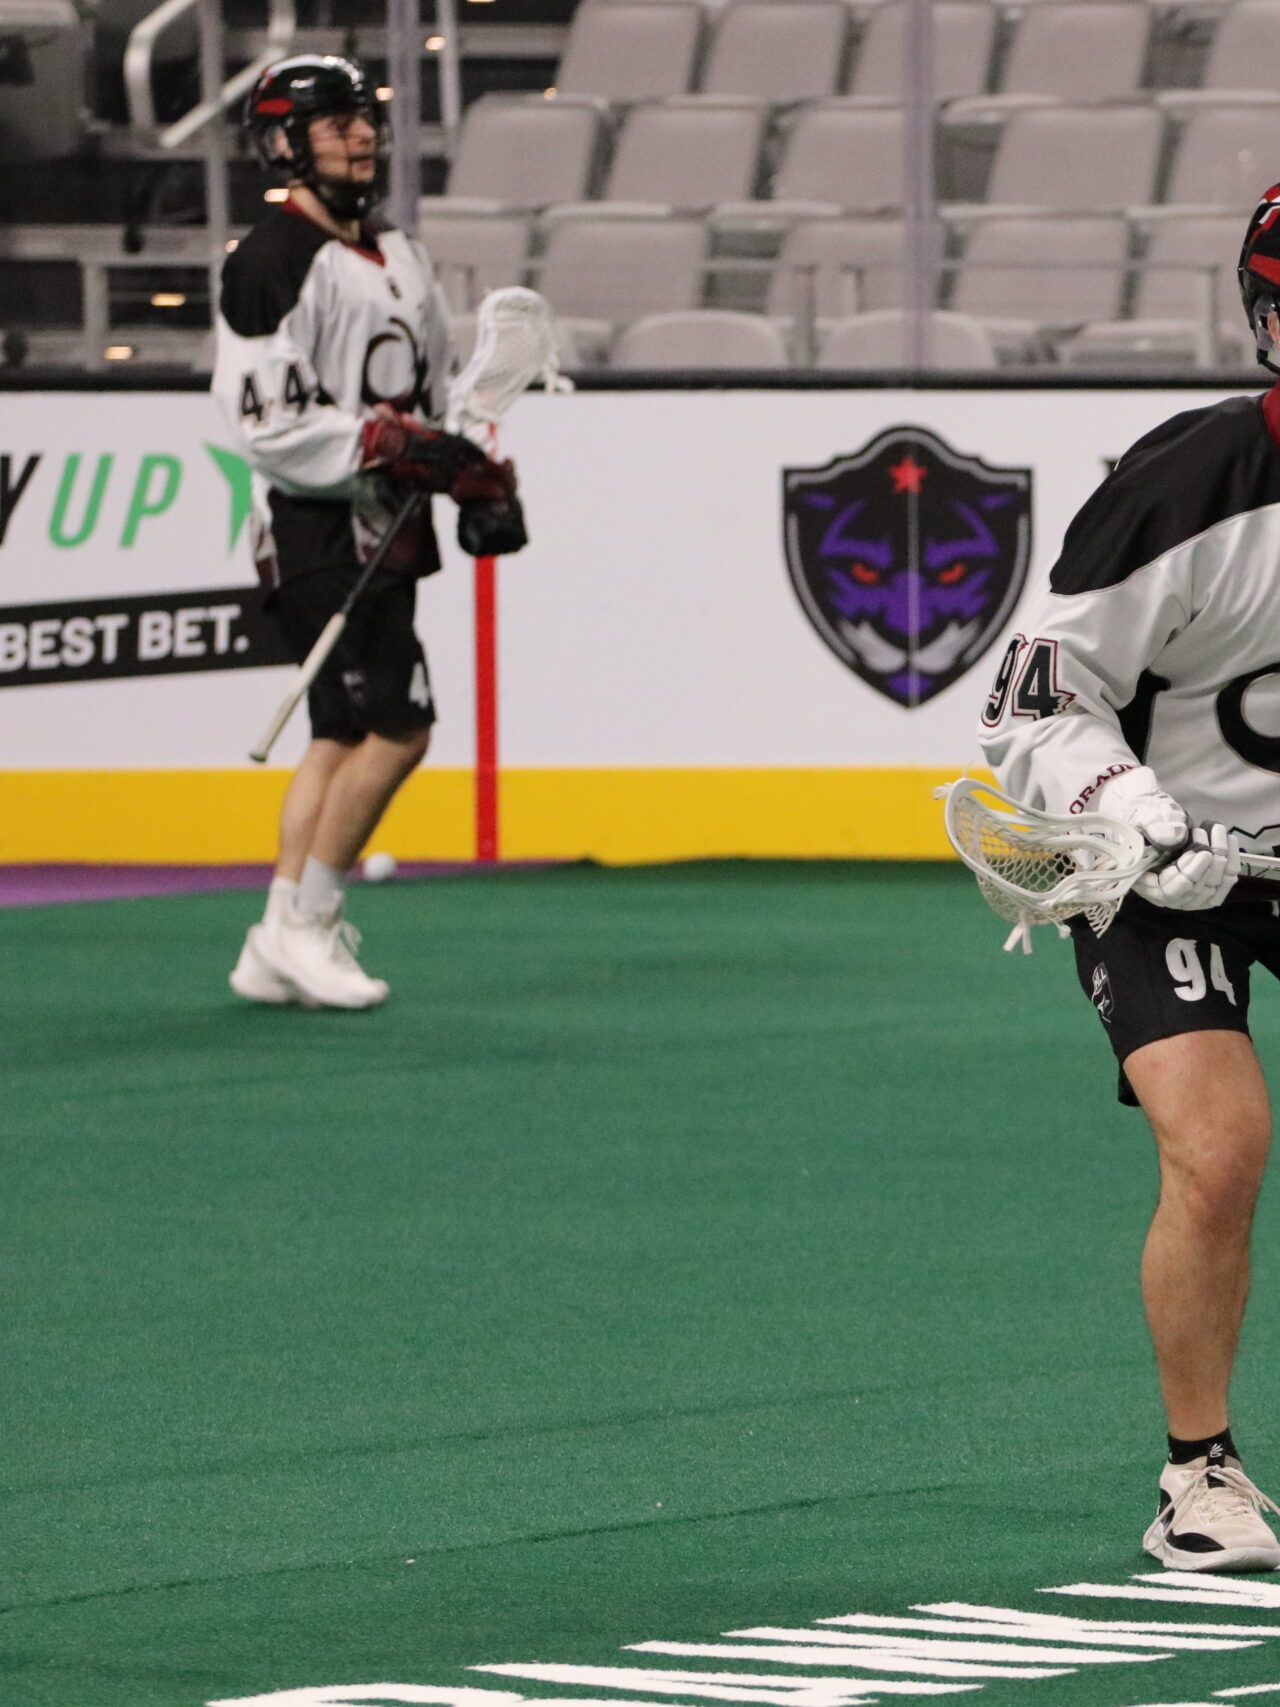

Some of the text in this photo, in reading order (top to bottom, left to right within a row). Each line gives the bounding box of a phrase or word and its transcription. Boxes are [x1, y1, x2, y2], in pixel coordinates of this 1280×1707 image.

[0, 604, 249, 672] BEST BET.
[981, 632, 1078, 728] 94
